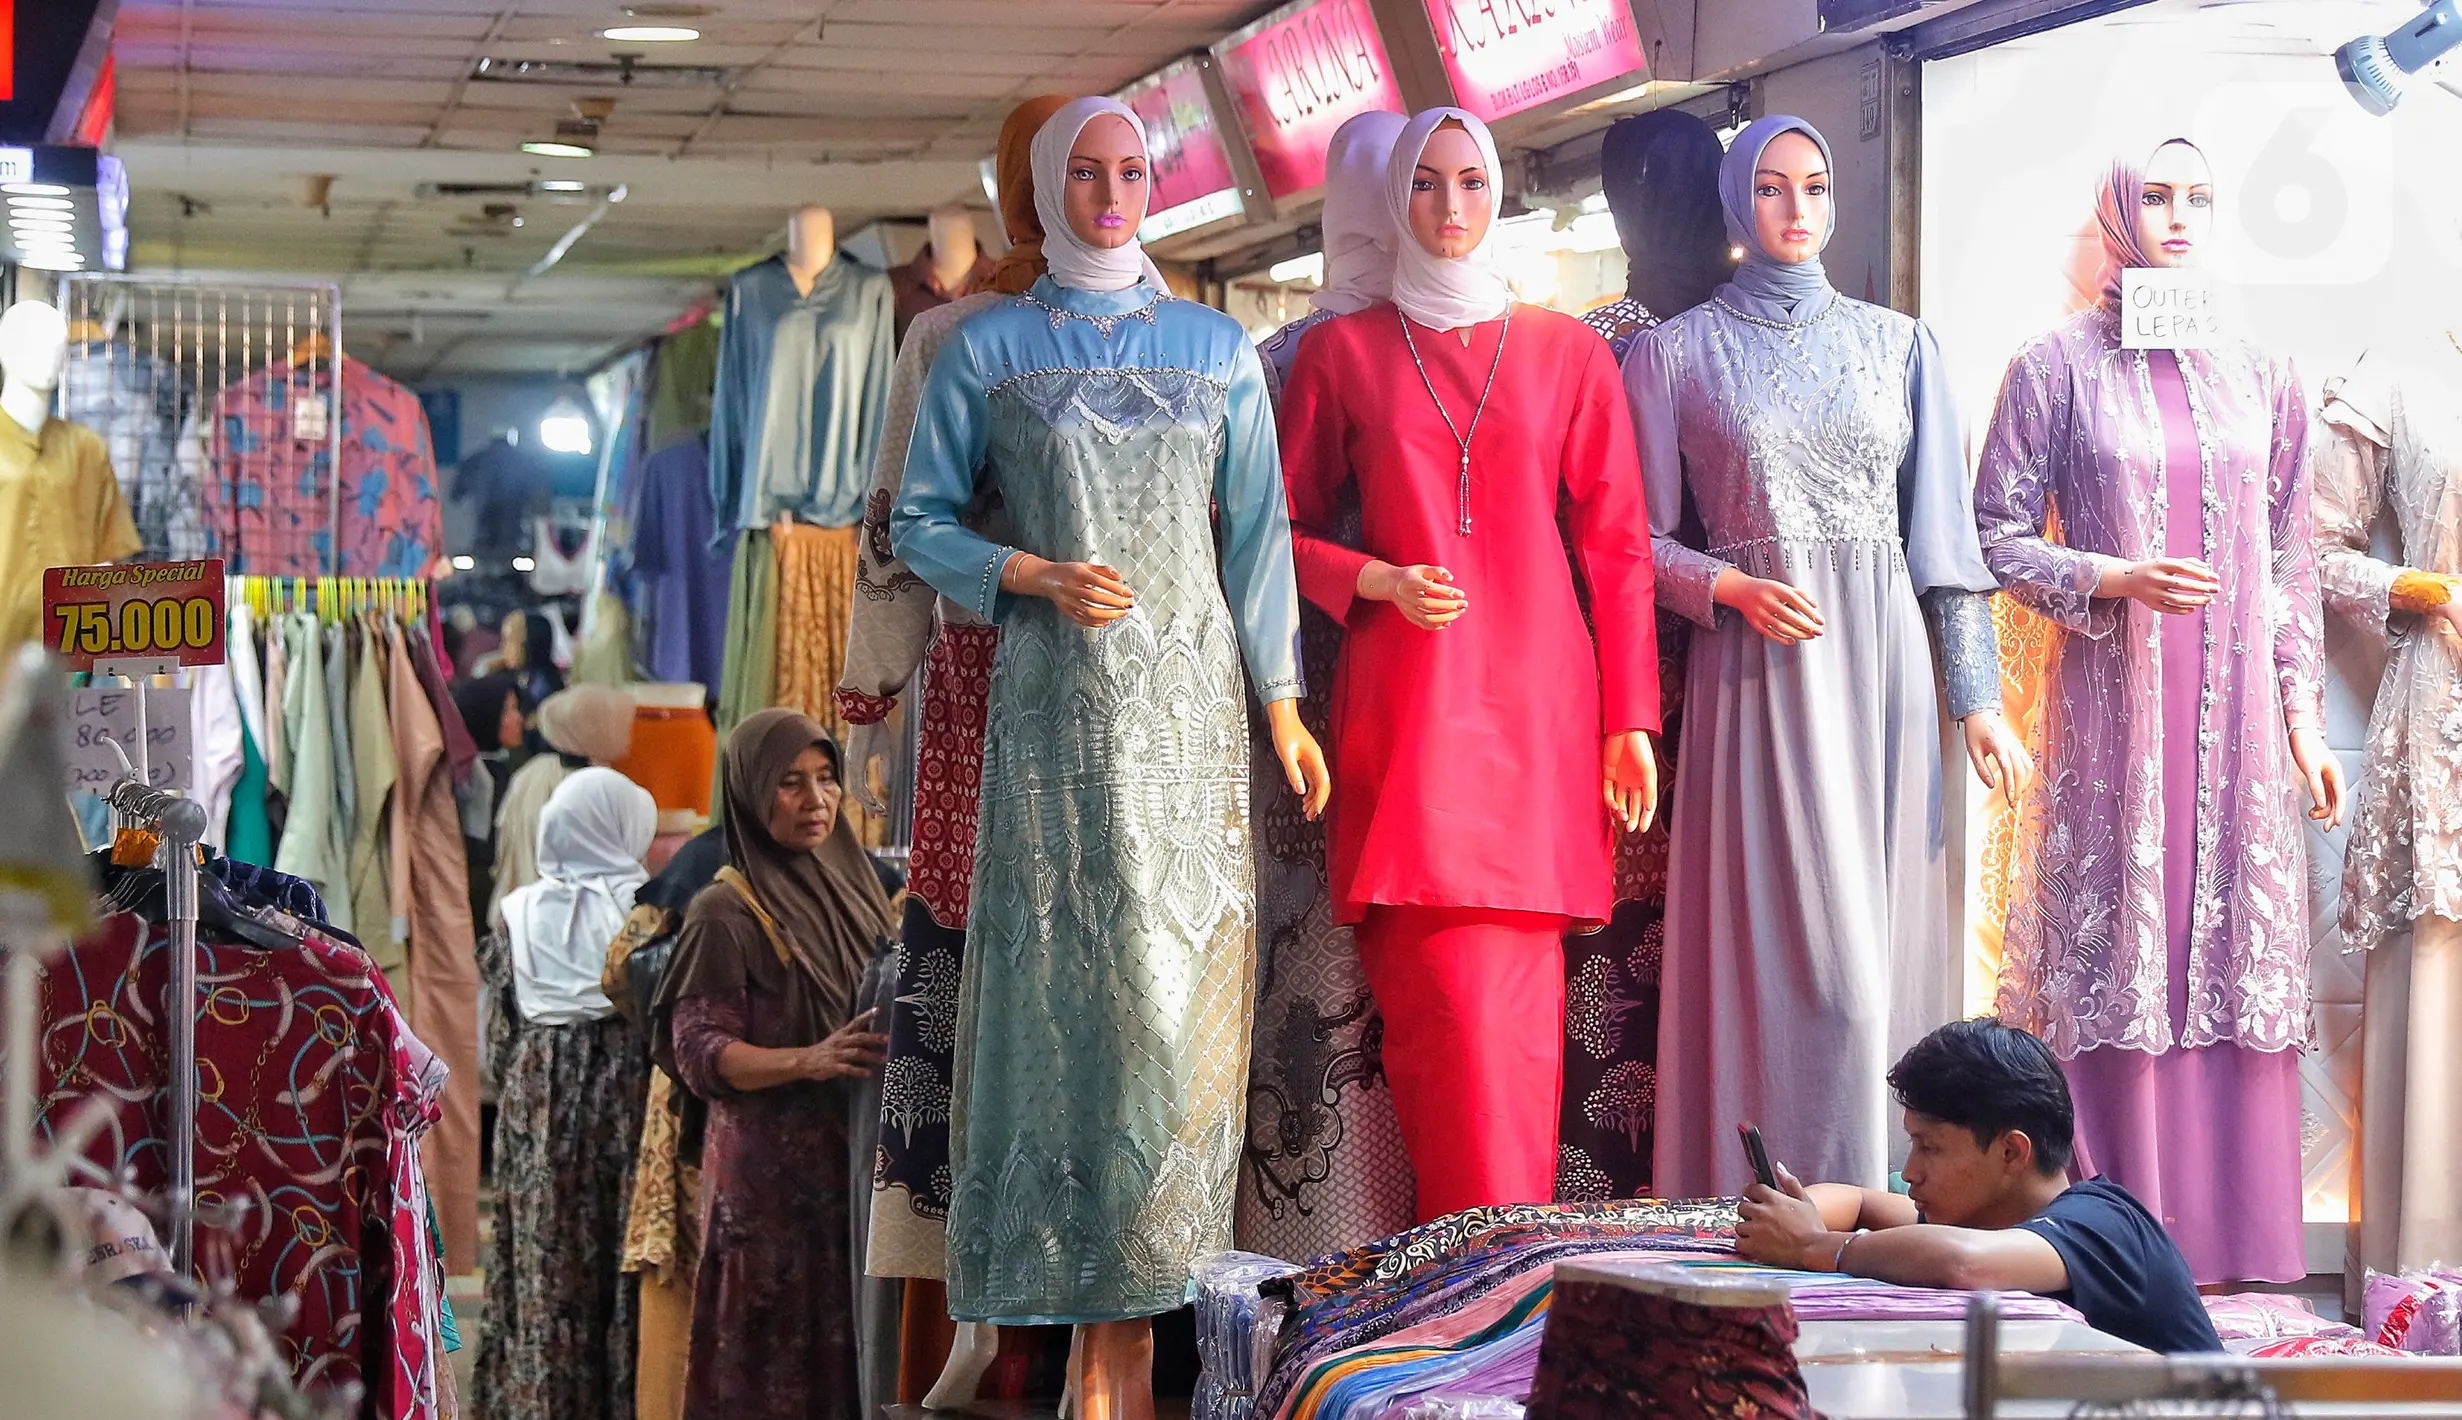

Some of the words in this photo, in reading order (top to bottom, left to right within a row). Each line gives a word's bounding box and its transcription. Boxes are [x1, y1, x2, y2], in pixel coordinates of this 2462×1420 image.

[1596, 14, 1628, 46] Wear
[62, 568, 126, 590] Harga
[130, 562, 205, 587] Special
[55, 598, 213, 653] 75.000
